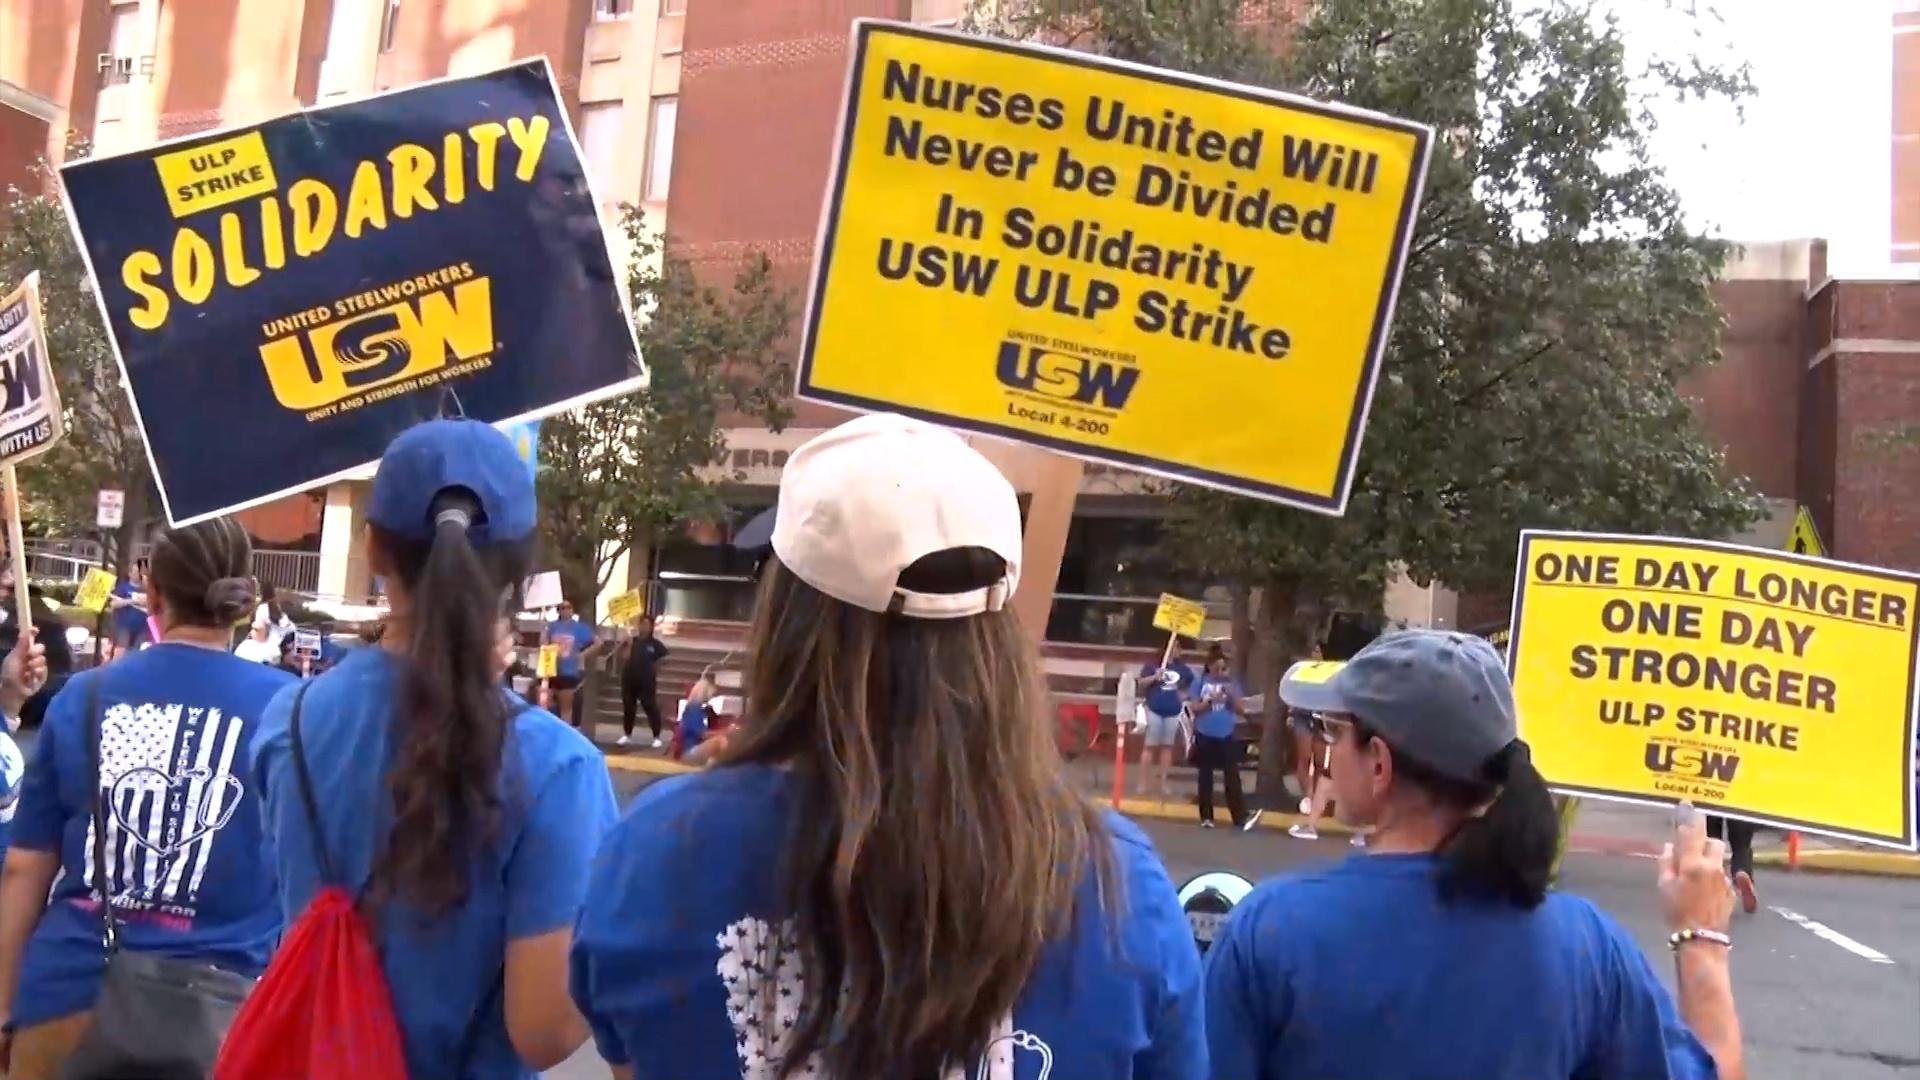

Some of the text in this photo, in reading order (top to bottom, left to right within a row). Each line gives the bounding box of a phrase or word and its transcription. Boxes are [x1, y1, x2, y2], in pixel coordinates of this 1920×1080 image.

[883, 59, 1378, 193] Nurses United Will
[177, 165, 264, 202] STRIKE
[189, 149, 236, 173] ULP
[884, 115, 1335, 243] Never be Divided
[121, 116, 550, 331] SOLIDARITY
[935, 193, 1254, 302] In Solidarity
[261, 262, 474, 337] UNITED STEELWORKERS
[876, 238, 1290, 360] USW ULP Strike
[258, 275, 494, 409] USW
[1007, 329, 1048, 345] UNITED
[305, 357, 492, 422] UNITY AND STRENGTH FOR WORKERS
[996, 341, 1141, 410] USW
[34, 421, 50, 442] US
[1008, 402, 1055, 425] Local
[1060, 416, 1109, 436] 4-200
[1535, 553, 1907, 627] ONE DAY LONGER
[1601, 599, 1815, 658] ONE DAY
[1569, 644, 1836, 714] STRONGER
[1599, 699, 1665, 727] ULP
[1676, 706, 1799, 751] STRIKE
[1644, 743, 1740, 783] USW
[1655, 781, 1688, 794] Local
